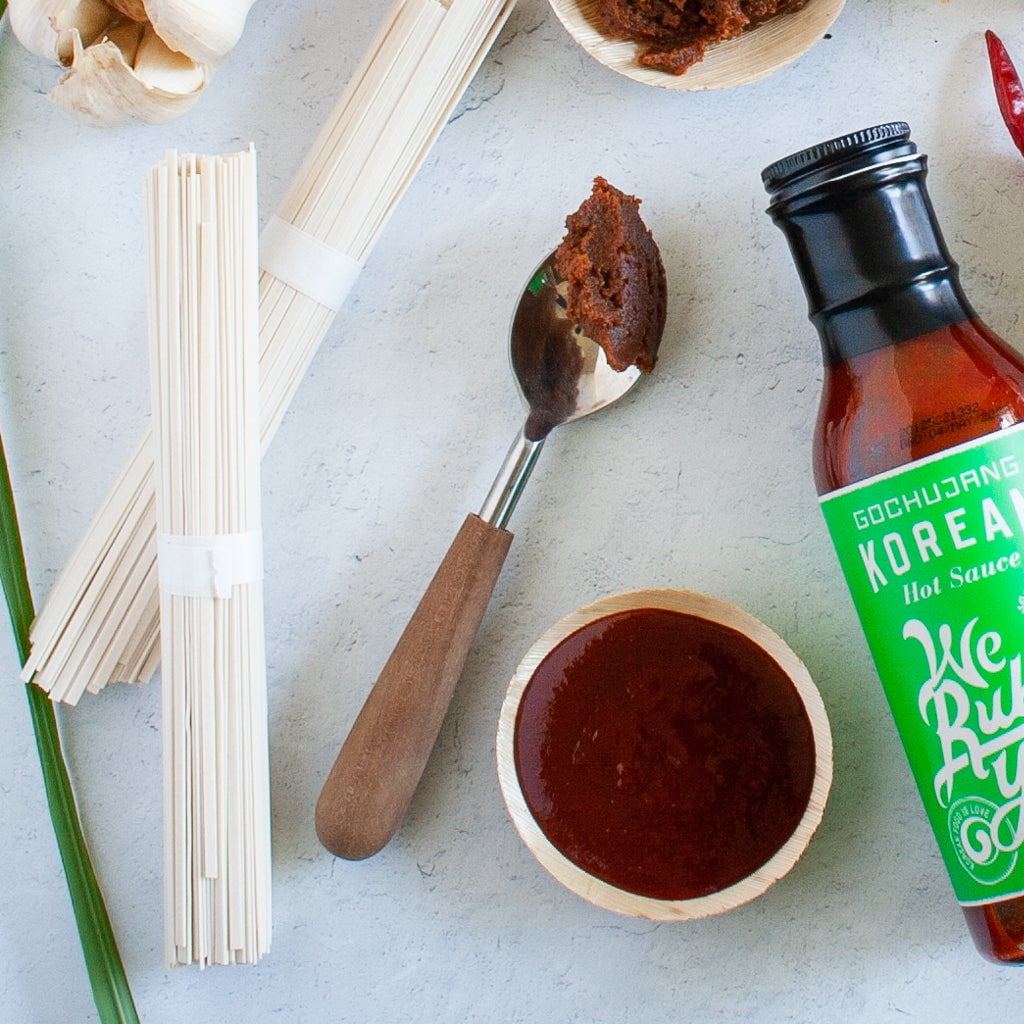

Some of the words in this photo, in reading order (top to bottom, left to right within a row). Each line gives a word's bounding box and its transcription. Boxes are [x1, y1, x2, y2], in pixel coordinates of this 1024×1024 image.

[852, 455, 1021, 531] GOCHUJANG
[903, 576, 942, 606] Hot
[949, 551, 1021, 589] Sauce
[902, 616, 1006, 689] We
